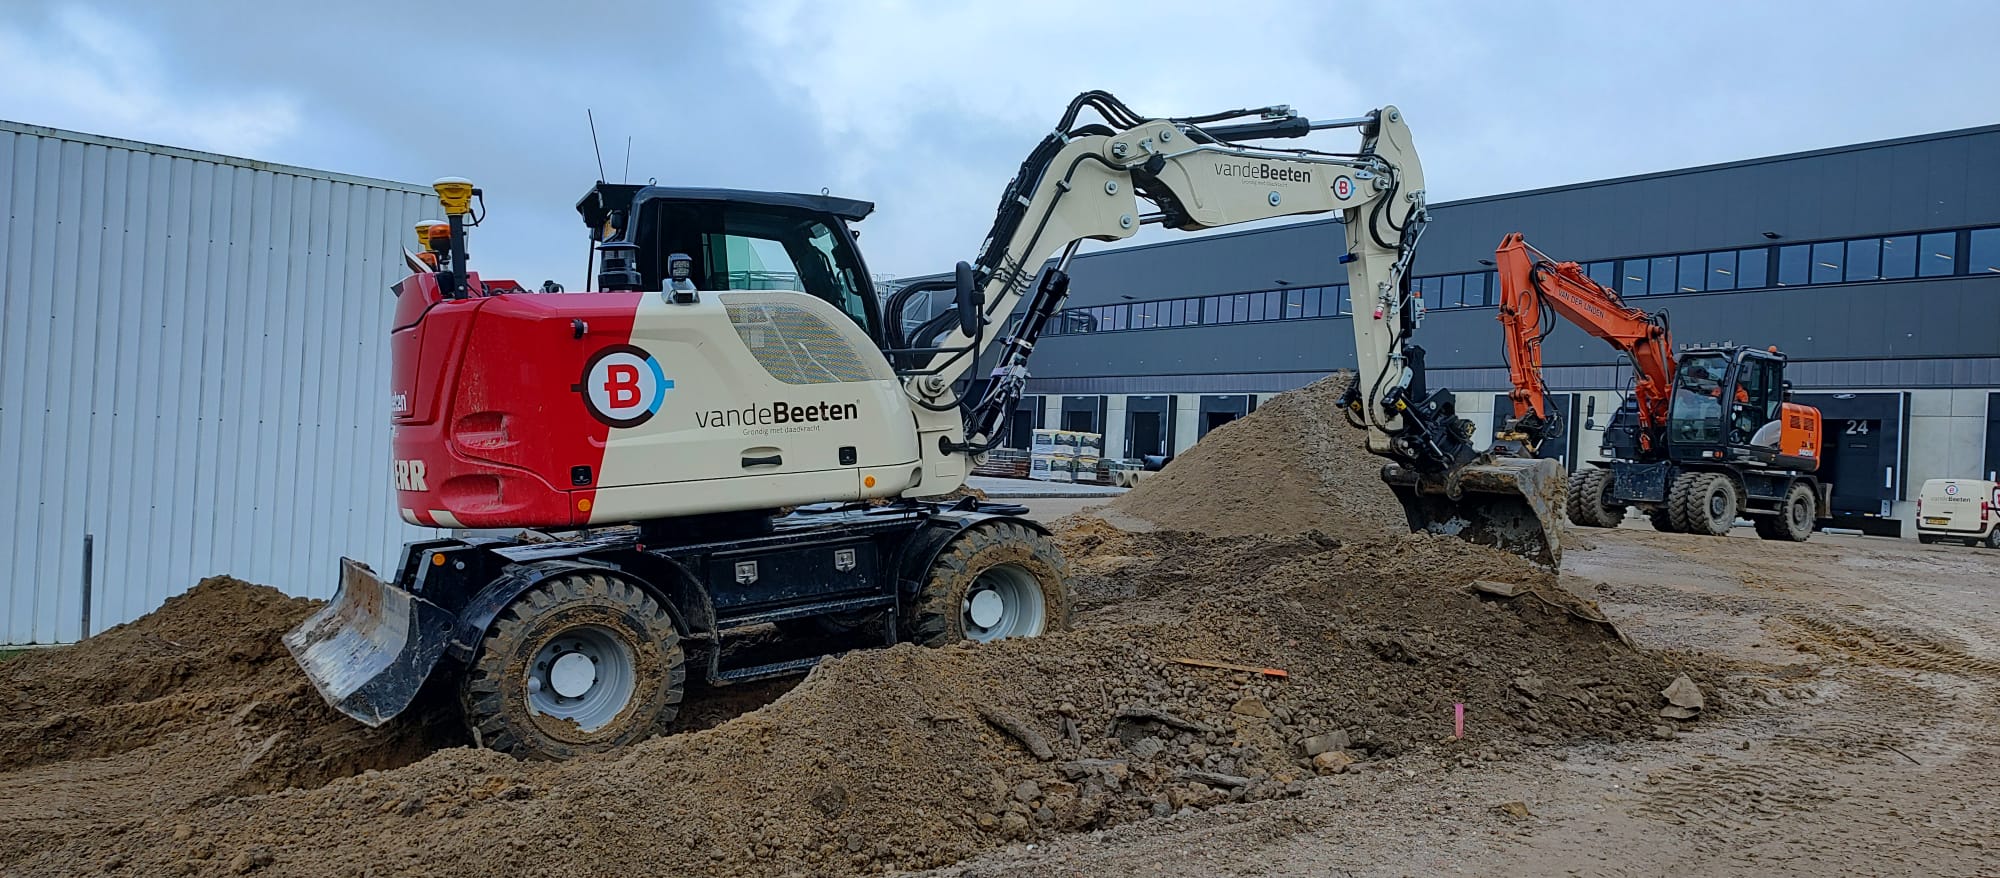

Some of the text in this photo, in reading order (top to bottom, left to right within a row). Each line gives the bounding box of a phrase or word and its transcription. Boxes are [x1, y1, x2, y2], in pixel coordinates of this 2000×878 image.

[1215, 162, 1311, 183] vandeBeeten
[1339, 180, 1348, 195] B
[1558, 289, 1604, 318] VAN DER LINDEN
[604, 364, 641, 409] B
[695, 401, 858, 428] vandeBeeten
[1845, 420, 1869, 435] 24
